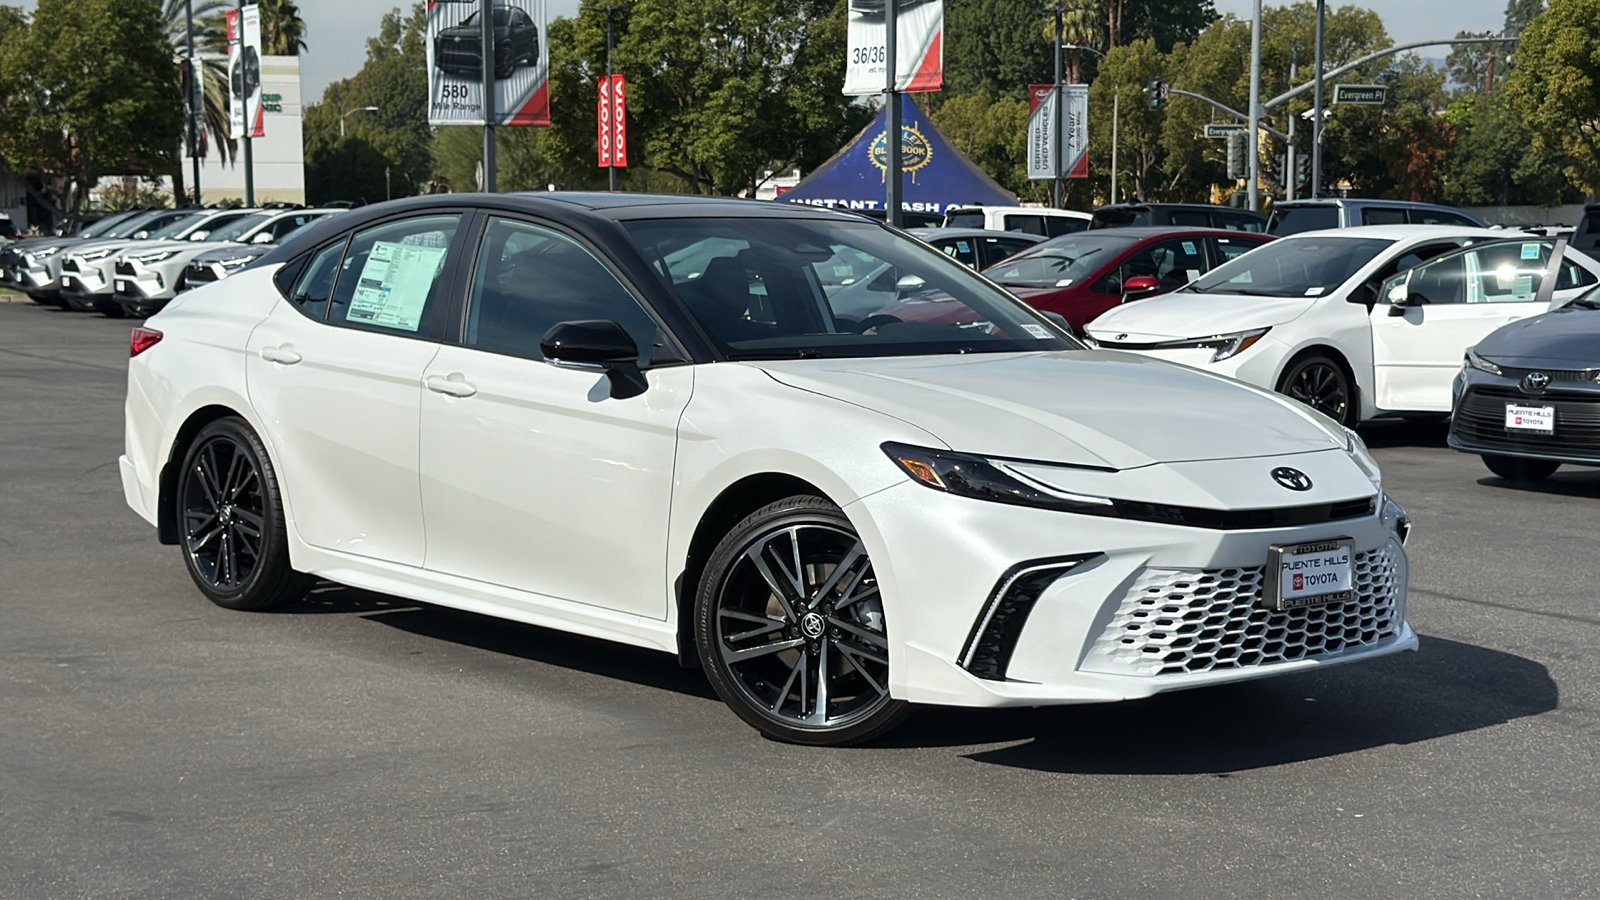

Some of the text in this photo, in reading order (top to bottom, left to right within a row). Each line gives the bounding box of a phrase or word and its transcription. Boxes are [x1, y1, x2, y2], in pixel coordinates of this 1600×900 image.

[853, 45, 885, 65] 36/36
[443, 84, 468, 98] 580
[1340, 90, 1383, 102] Evergreen Pl
[453, 102, 481, 113] Range
[601, 81, 609, 162] TOYOTA
[615, 80, 624, 162] TOYOTA
[901, 145, 926, 156] BOOK
[789, 198, 878, 210] STANT
[884, 201, 940, 213] ASH
[1508, 409, 1533, 417] PUENTE
[1299, 542, 1337, 554] TOYOTA
[1282, 555, 1349, 571] PUENTE HILLS
[1305, 573, 1338, 586] TOYOTA
[1284, 592, 1350, 608] PUENTE HILLS
